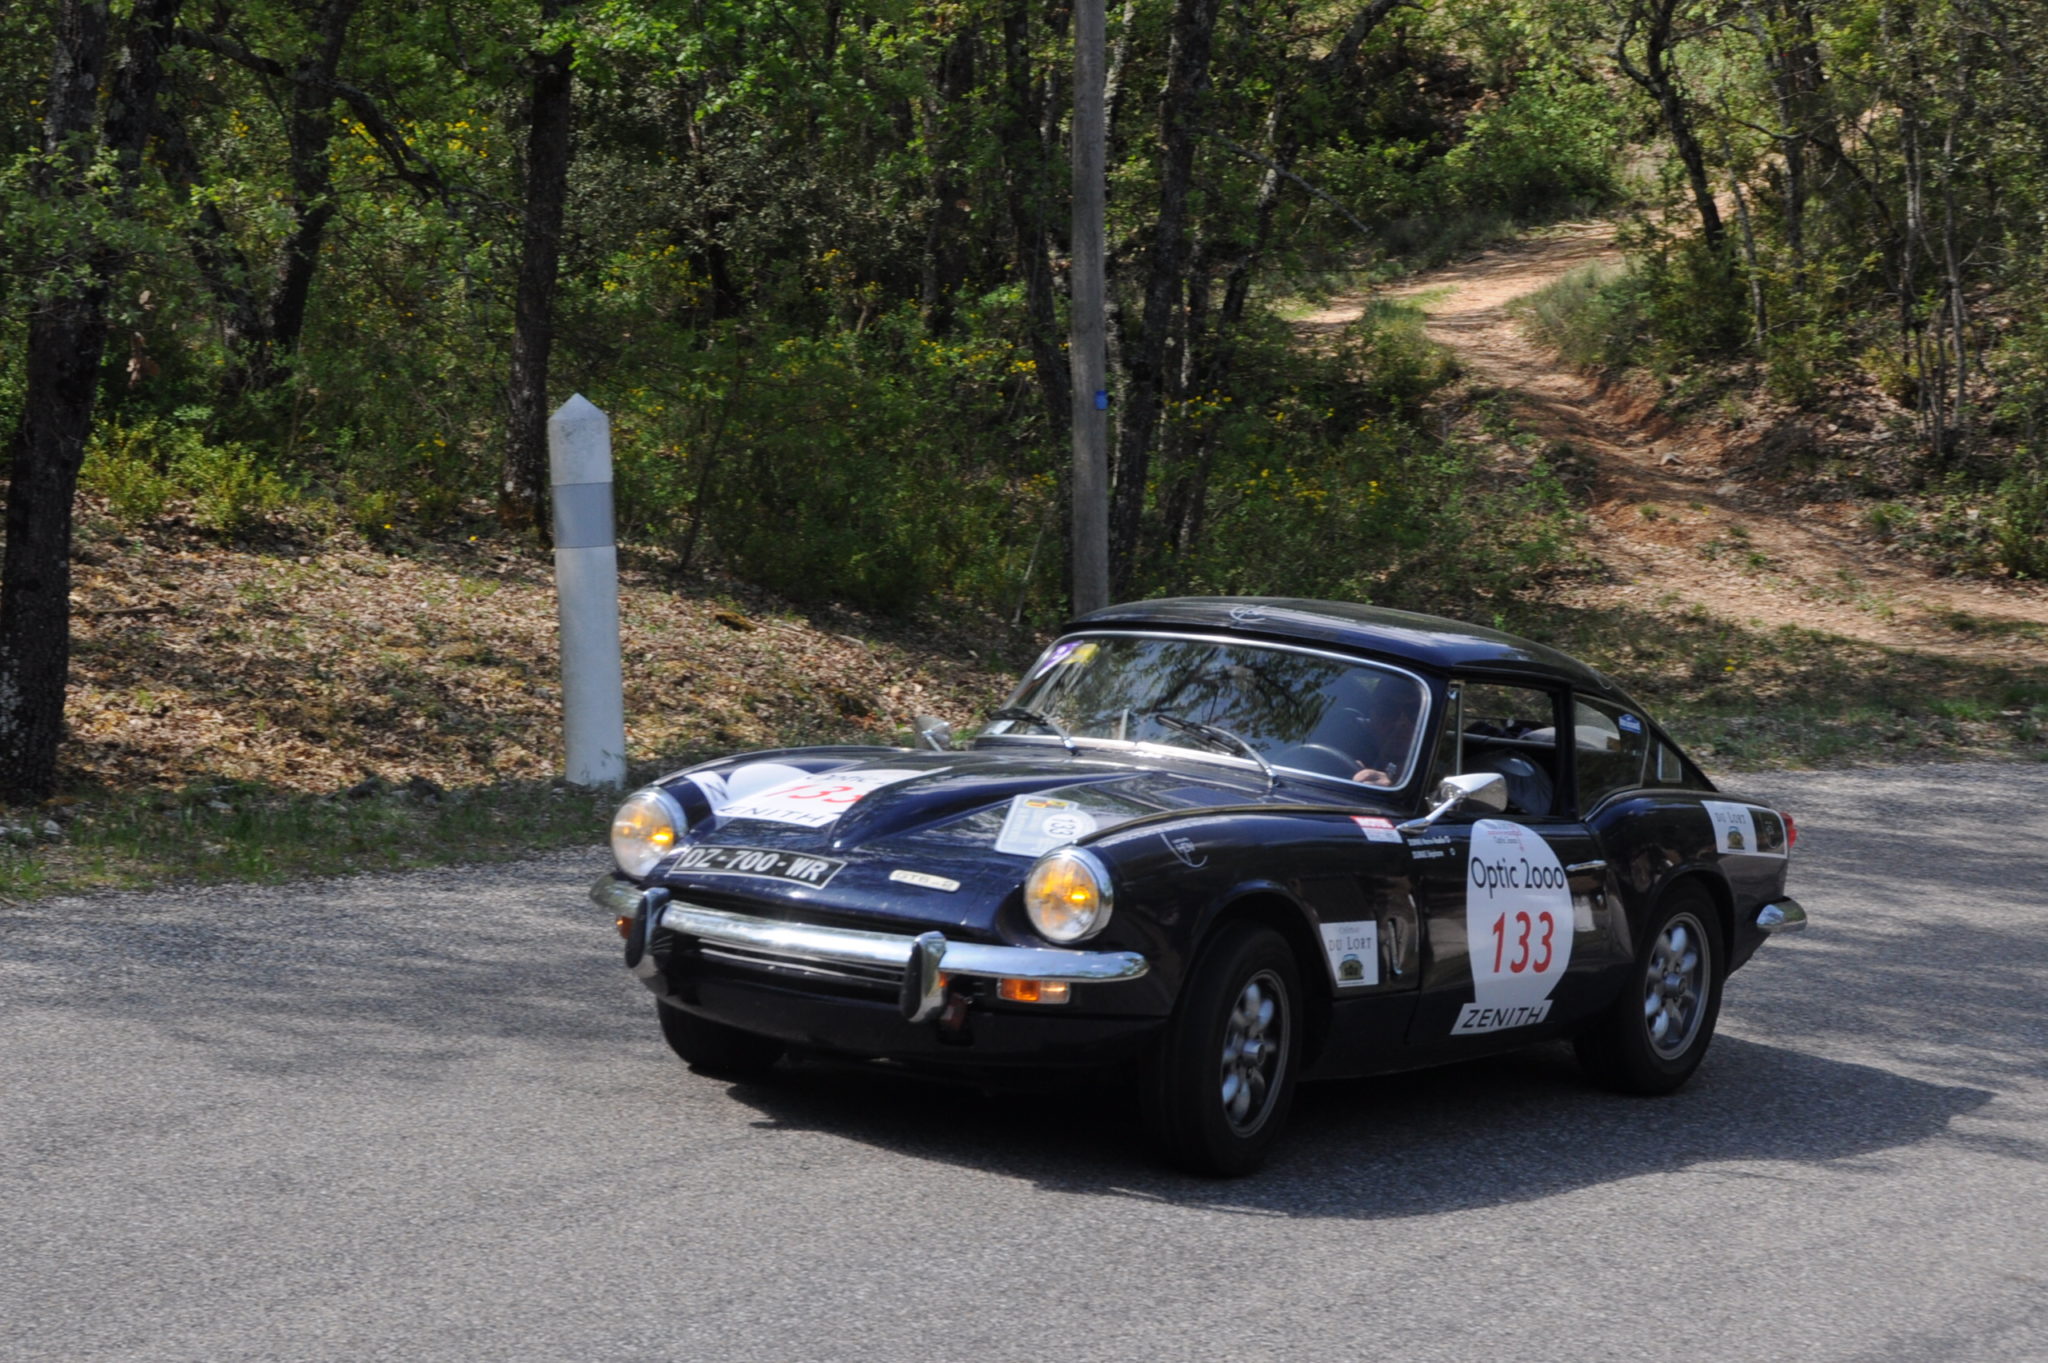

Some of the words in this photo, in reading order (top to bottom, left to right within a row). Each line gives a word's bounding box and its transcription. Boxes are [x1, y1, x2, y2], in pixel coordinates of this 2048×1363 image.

[679, 848, 830, 881] DZ-700-WR
[1470, 856, 1519, 899] Optic
[1519, 858, 1565, 889] 2000
[1492, 911, 1554, 974] 133
[1462, 1006, 1544, 1029] ZENITH
